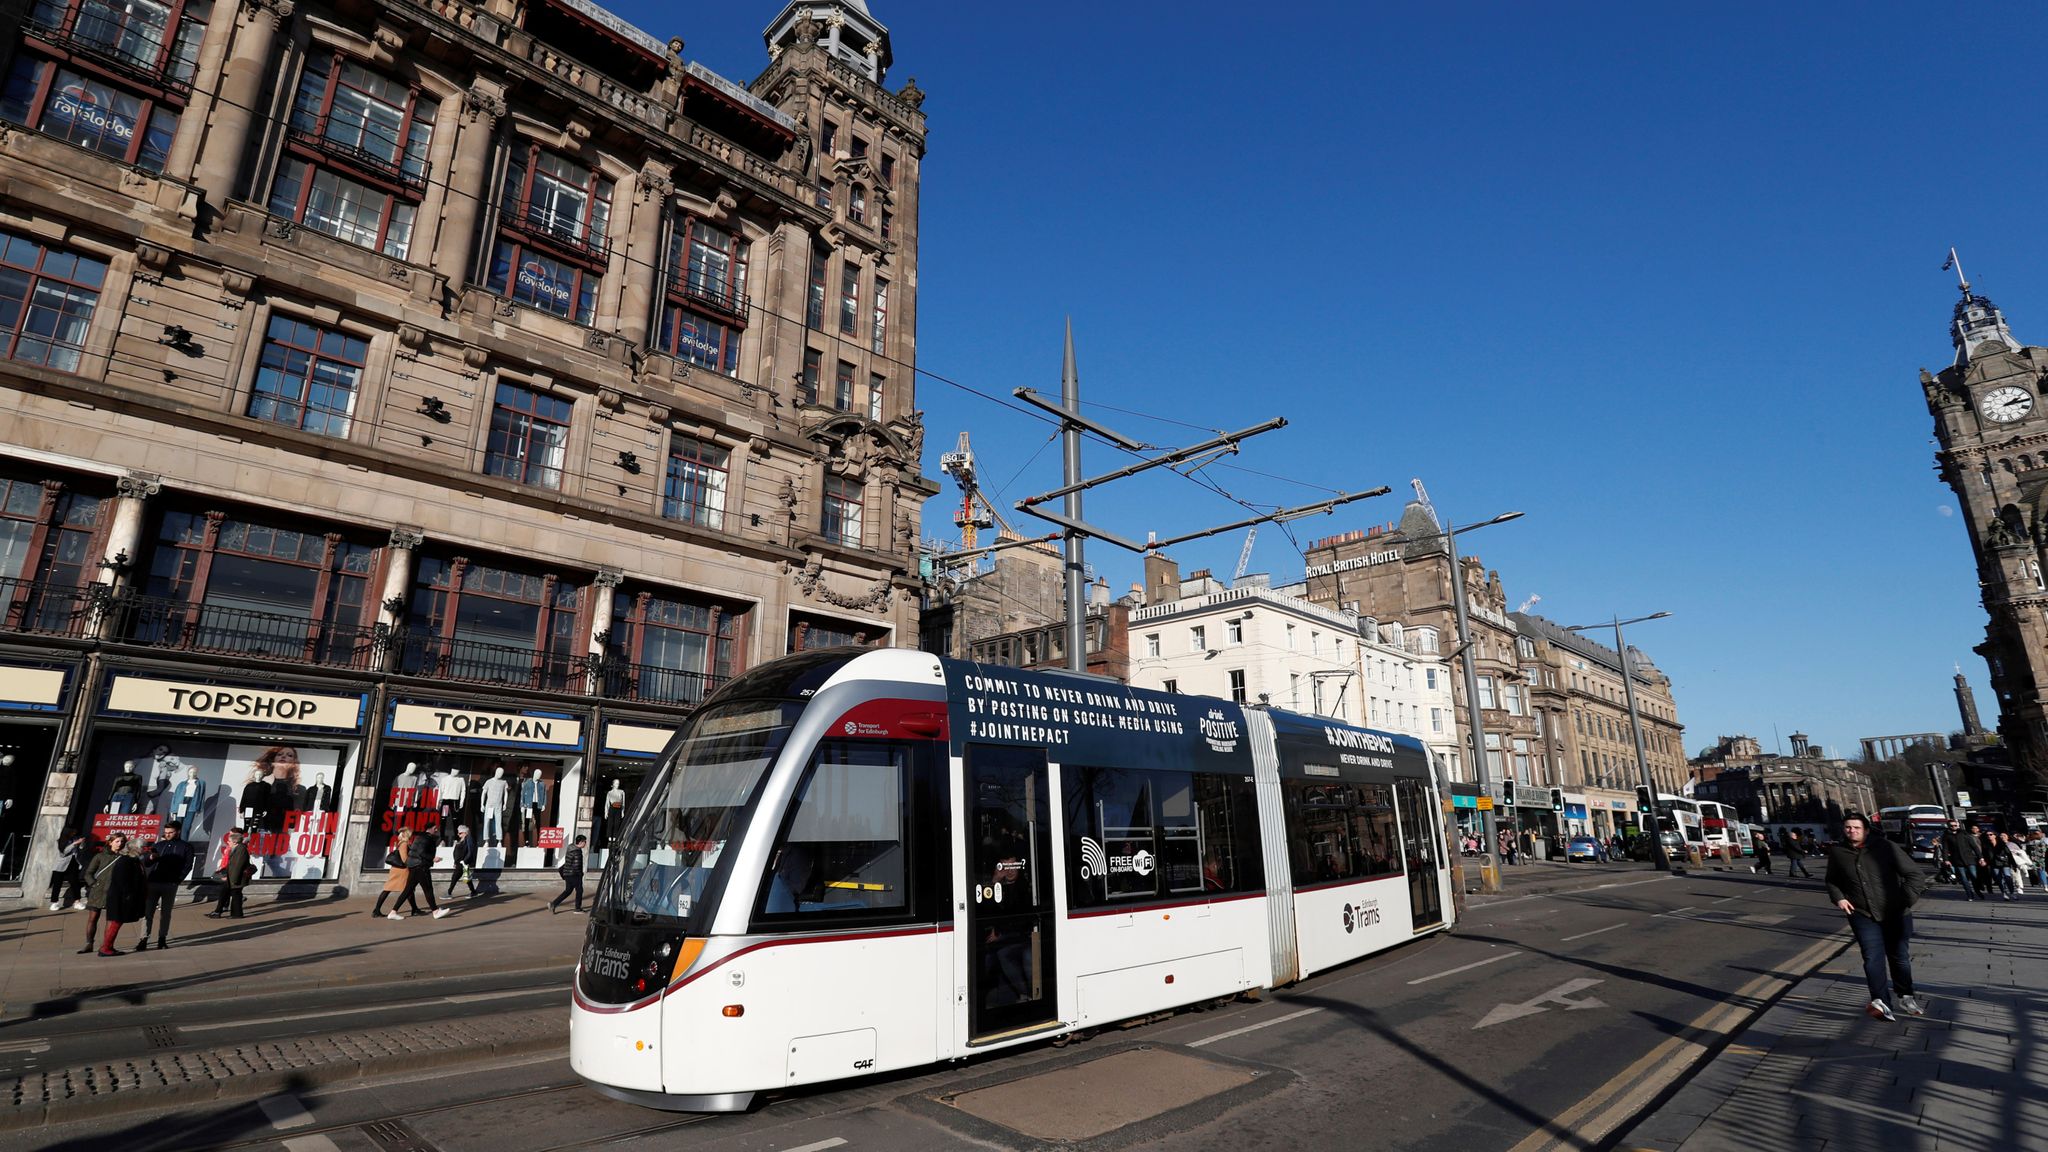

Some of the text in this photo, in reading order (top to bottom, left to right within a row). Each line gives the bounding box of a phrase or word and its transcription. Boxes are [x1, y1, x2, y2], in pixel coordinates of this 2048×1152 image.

[1306, 549, 1400, 579] ROYAL BRITISH HOTEL
[168, 687, 317, 721] TOPSHOP
[800, 689, 815, 697] 257
[965, 675, 1177, 716] COMMIT TO NEVER DRINK AND DRIVE
[433, 712, 552, 740] TOPMAN
[858, 722, 880, 730] Transport
[967, 697, 1183, 735] BY POSTING ON SOCIAL MEDIA USING
[1199, 716, 1239, 739] POSITIVE
[865, 728, 888, 736] Edinburgh
[970, 721, 1069, 744] #JOINTHEPACT
[1324, 726, 1395, 753] #JOINTHEPACT
[1340, 753, 1357, 764] NEVER
[388, 787, 440, 809] FIT IN
[282, 809, 340, 834] FIT IN
[297, 833, 336, 858] OUT
[1110, 856, 1133, 866] FREE
[1354, 906, 1381, 929] Trams
[593, 949, 630, 980] Trams
[604, 946, 631, 962] Edinburgh
[853, 1058, 874, 1070] CAF
